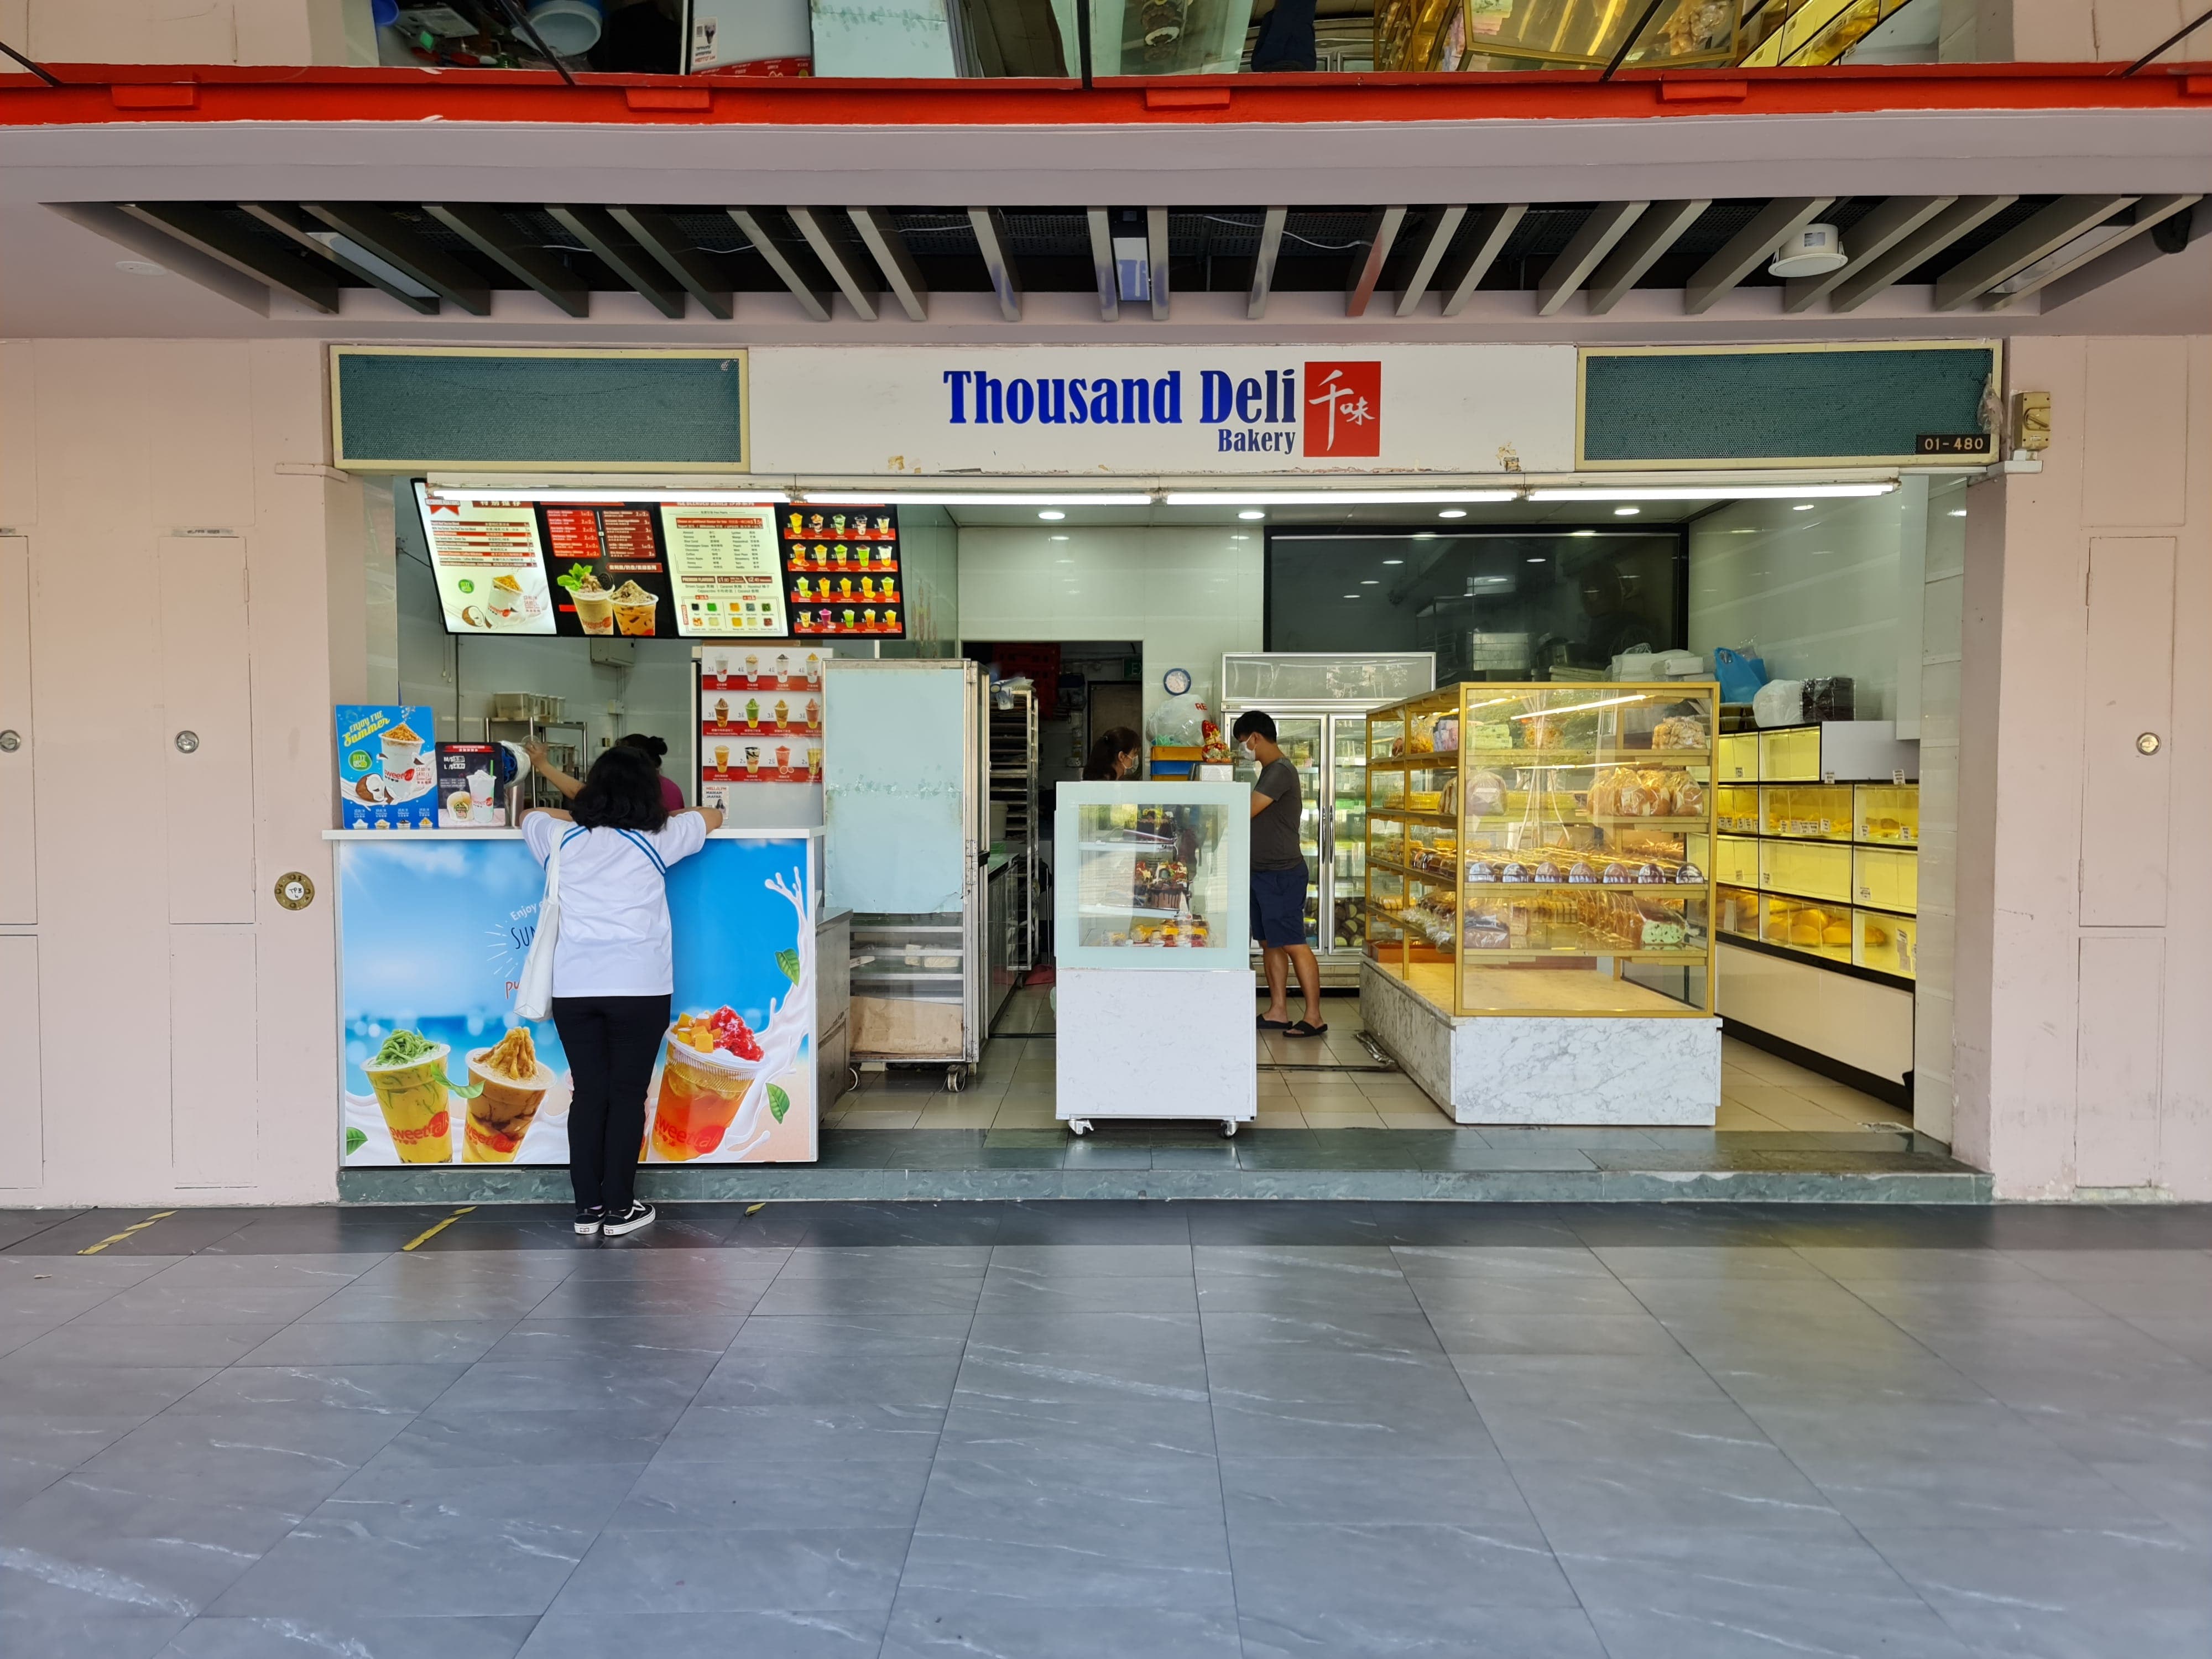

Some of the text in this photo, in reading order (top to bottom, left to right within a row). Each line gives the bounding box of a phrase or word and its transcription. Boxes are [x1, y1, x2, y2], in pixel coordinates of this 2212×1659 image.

[943, 368, 1296, 424] Thousand Deli
[1308, 369, 1376, 452] 千味
[1217, 429, 1296, 455] Bakery
[1924, 437, 1984, 451] 01-480
[510, 902, 536, 921] Enjoy
